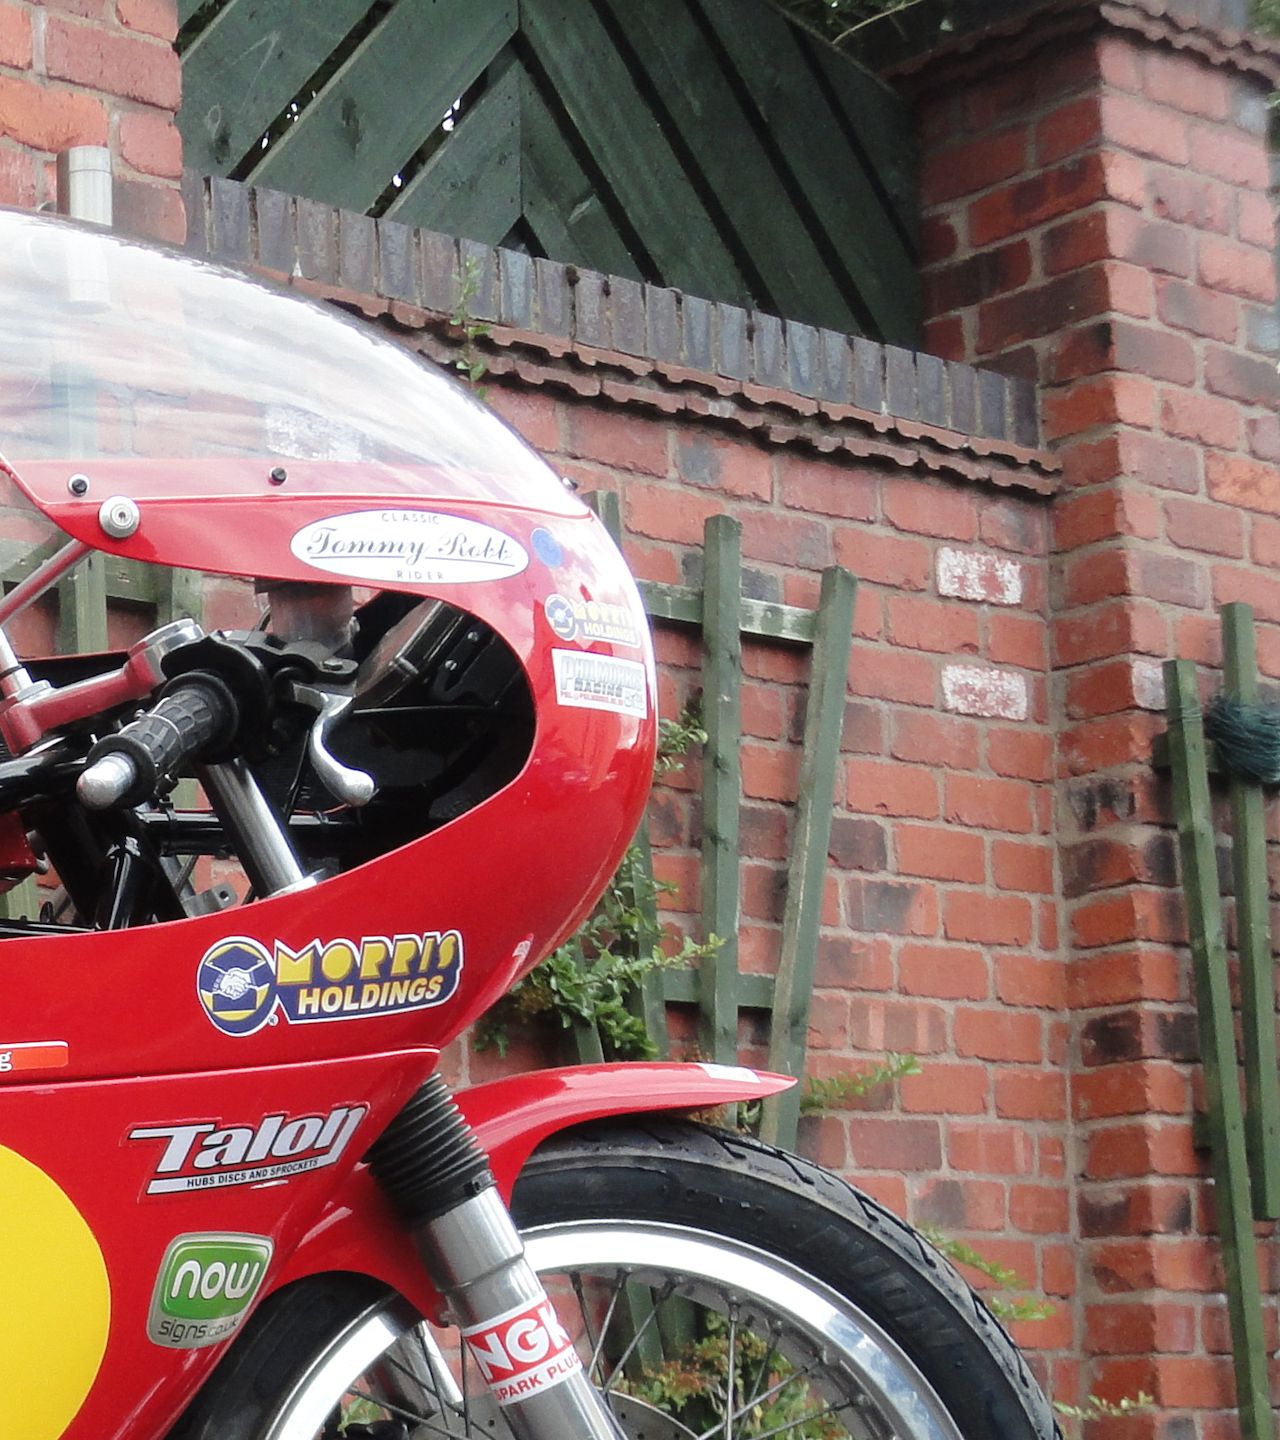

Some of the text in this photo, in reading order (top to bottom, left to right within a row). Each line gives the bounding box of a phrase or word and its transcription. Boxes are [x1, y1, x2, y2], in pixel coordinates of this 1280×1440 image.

[381, 512, 440, 525] CLASSIC
[306, 527, 513, 565] Tommy Robb
[396, 570, 444, 580] RIDER
[276, 933, 458, 985] MORRIS
[297, 975, 445, 1015] HOLDINGS
[129, 1106, 367, 1173] Talon
[186, 1158, 319, 1188] HUBS DISCS AND SPROCKETS
[171, 1260, 260, 1299] now
[469, 1305, 571, 1380] NGK
